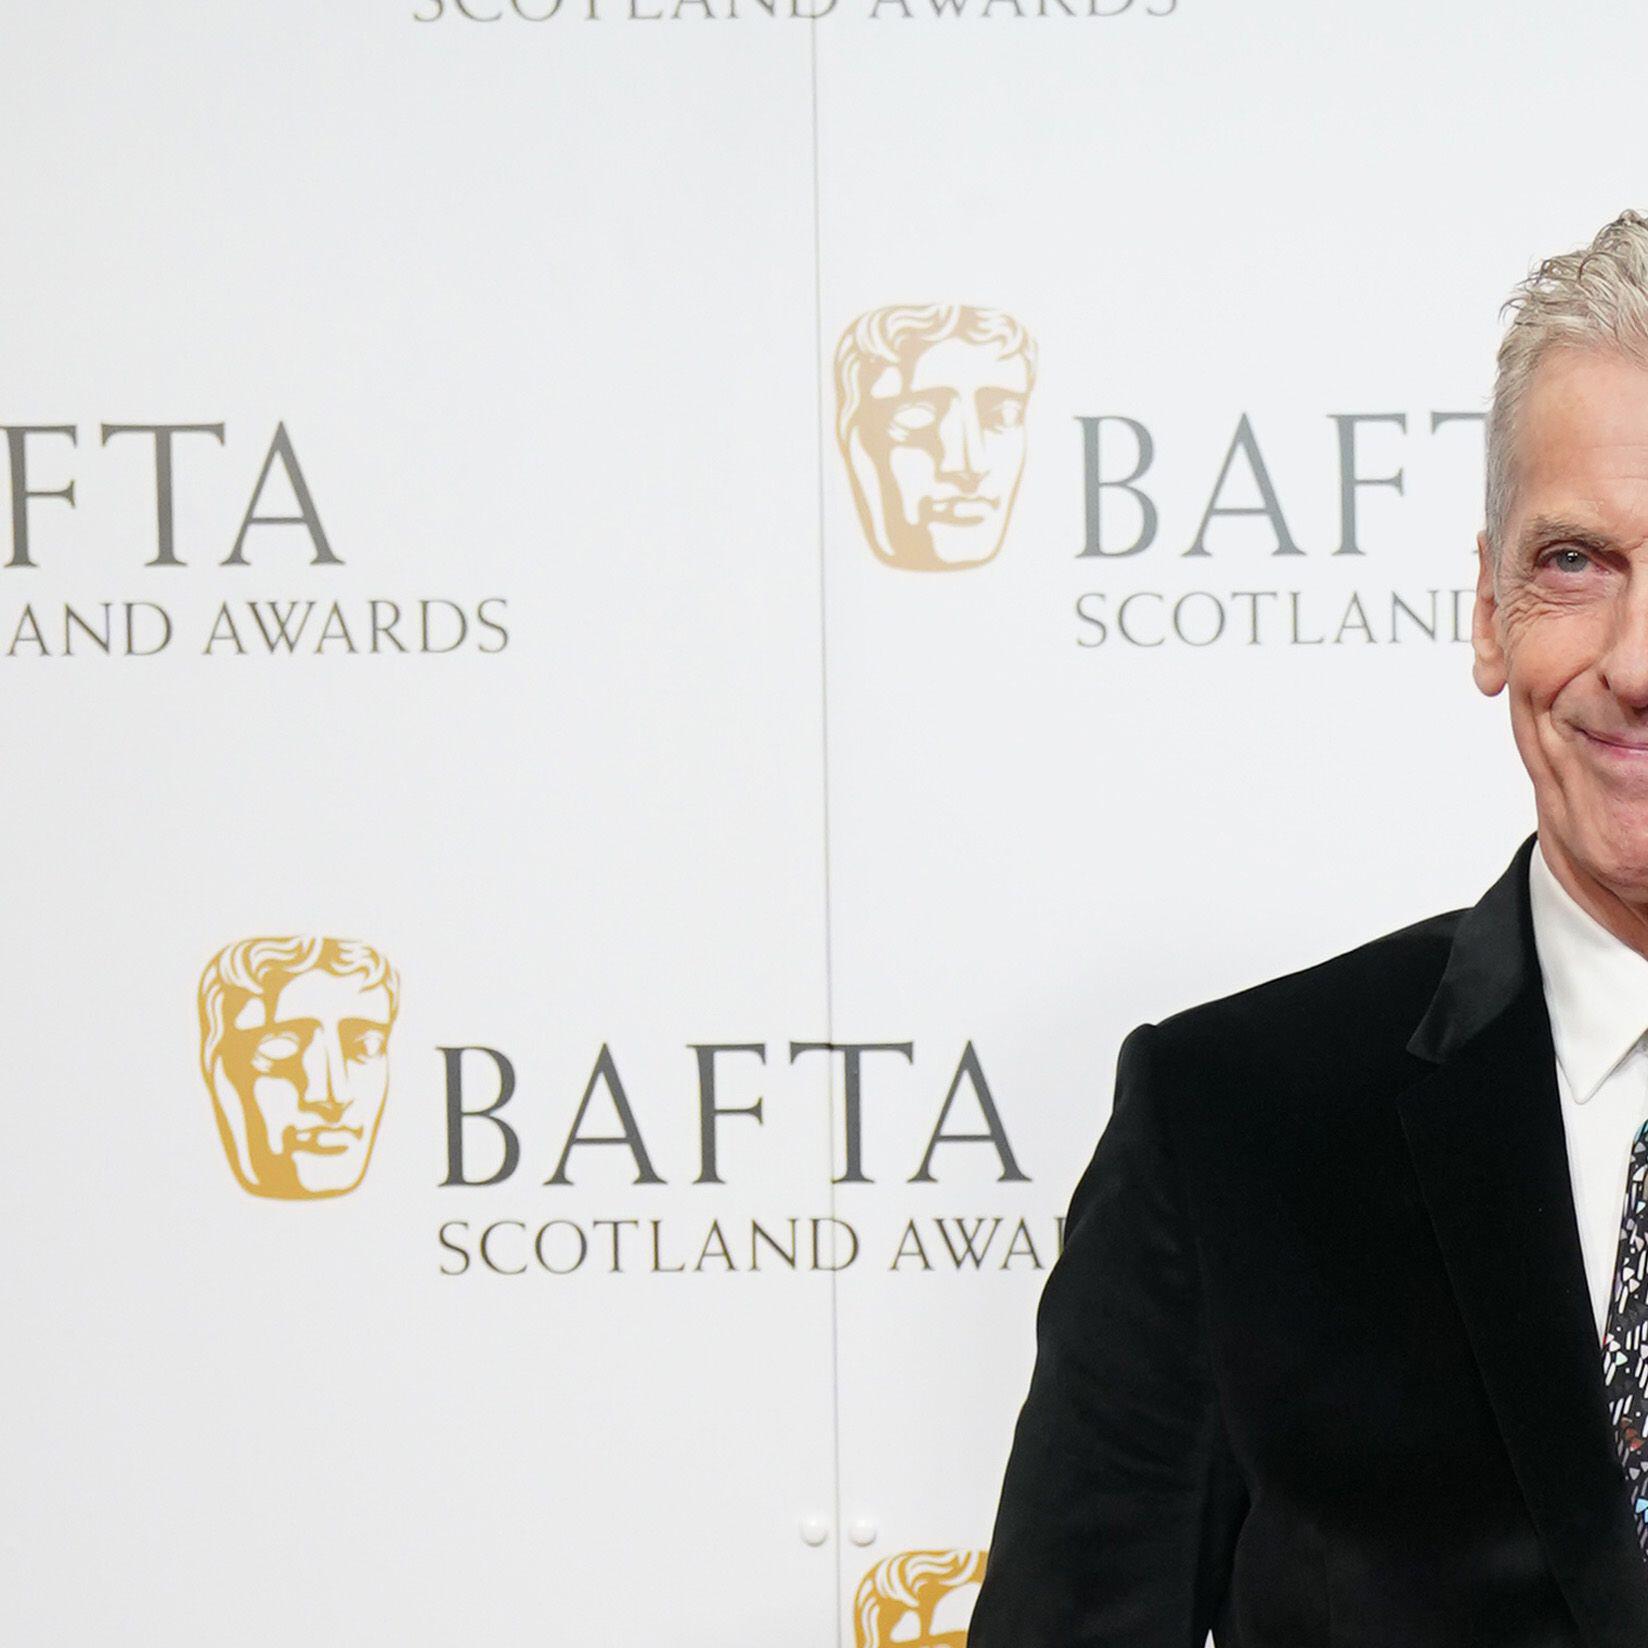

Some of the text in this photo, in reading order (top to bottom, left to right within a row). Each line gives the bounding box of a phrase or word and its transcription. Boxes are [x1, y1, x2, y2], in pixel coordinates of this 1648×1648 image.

[203, 598, 509, 655] AWARDS
[436, 1041, 1033, 1187] BAFTA
[438, 1216, 1066, 1275] SCOTLAND AWA
